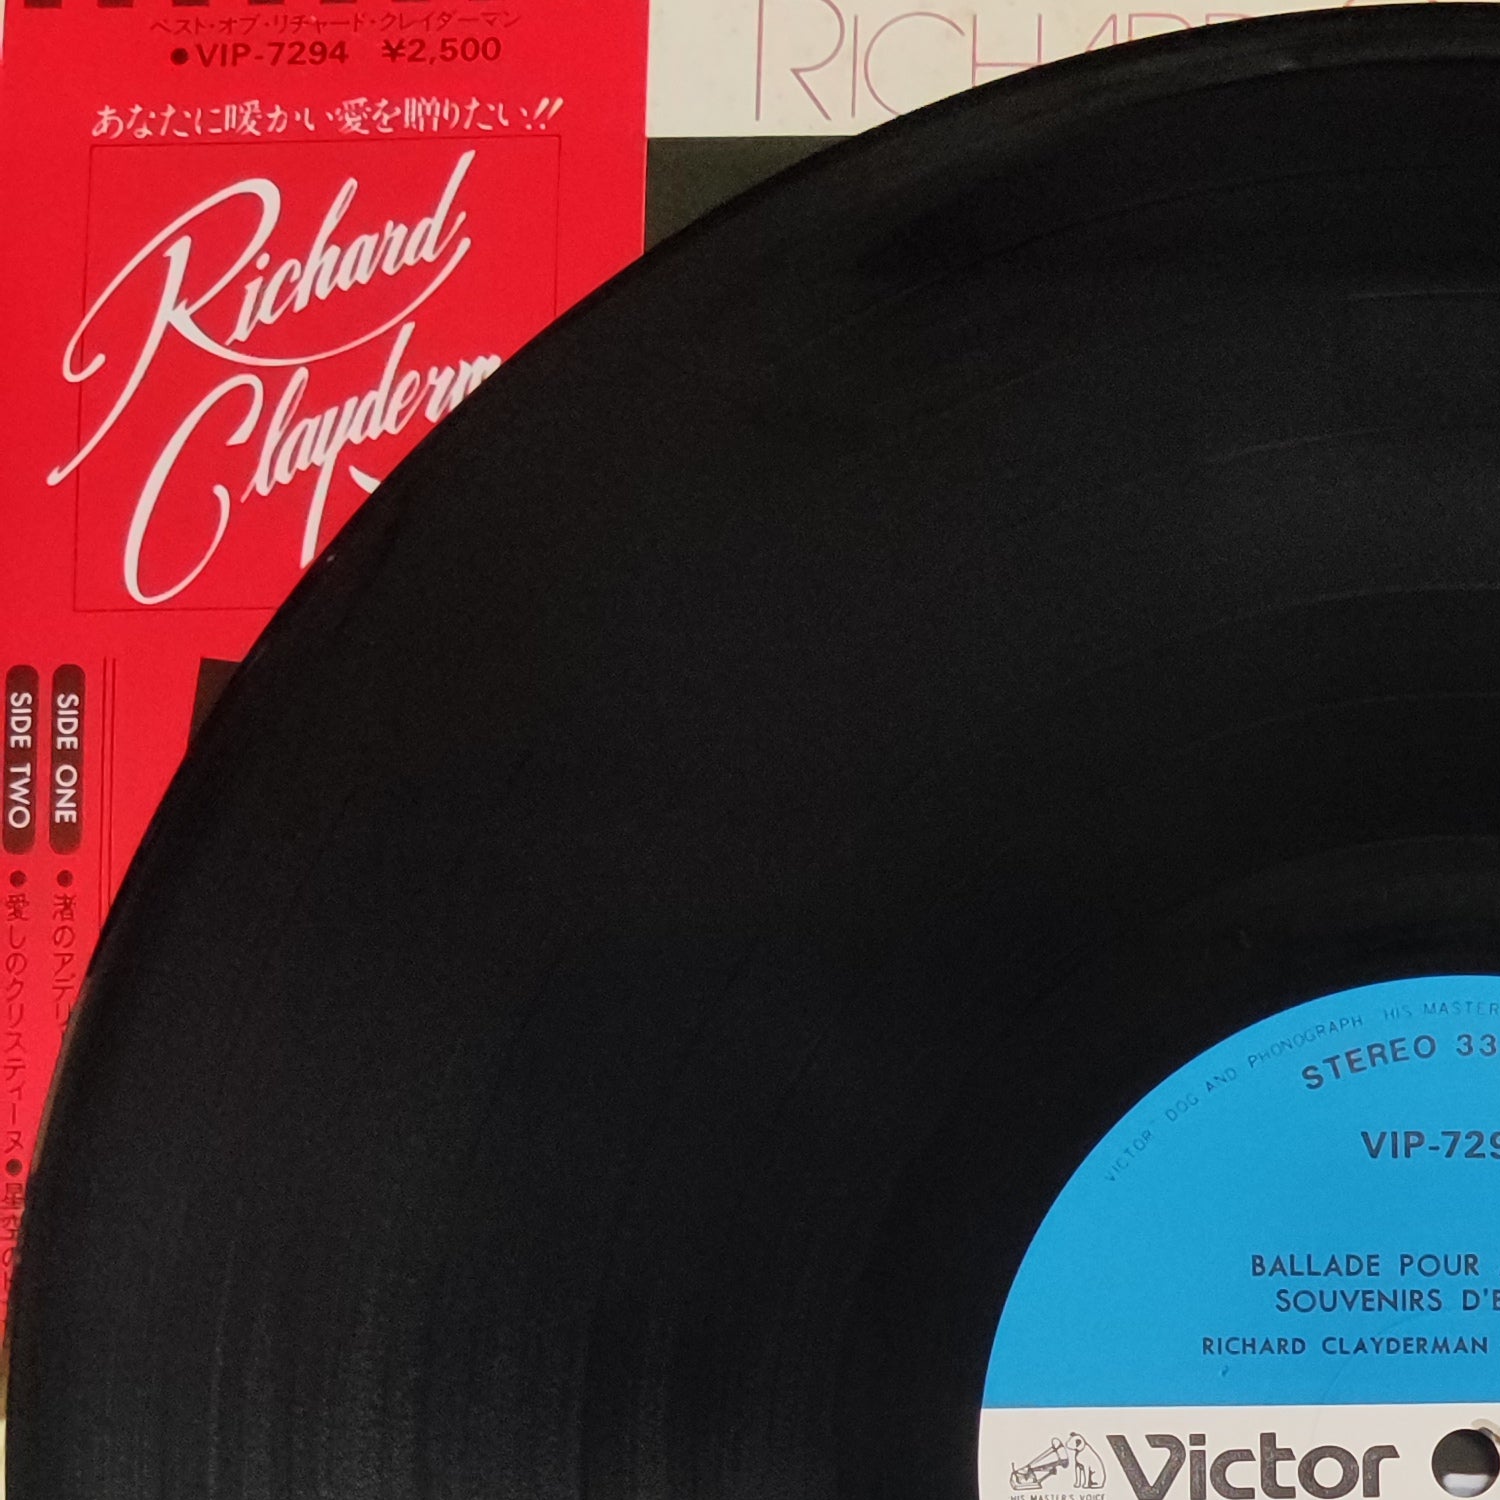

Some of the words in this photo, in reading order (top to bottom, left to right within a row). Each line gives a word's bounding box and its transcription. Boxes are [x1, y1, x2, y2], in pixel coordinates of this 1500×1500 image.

[381, 36, 502, 66] ¥2,500
[47, 150, 476, 486] Richard
[10, 691, 33, 749] SIDE
[55, 693, 80, 751] SIDE
[8, 762, 32, 829] TWO
[54, 764, 78, 825] ONE
[1301, 1033, 1438, 1091] STEREO
[1104, 1128, 1154, 1183] VICTOR
[1164, 1092, 1200, 1123] DOG
[1205, 1066, 1238, 1093] AND
[1246, 1014, 1364, 1069] PHONOGRAPH
[1383, 1004, 1414, 1022] HIS
[1251, 1253, 1381, 1277] BALLADE
[1400, 1253, 1480, 1277] POUR
[1275, 1288, 1443, 1313] SOUVENIRS
[1202, 1336, 1307, 1355] RICHARD
[1321, 1336, 1488, 1355] CLAYDERMAN
